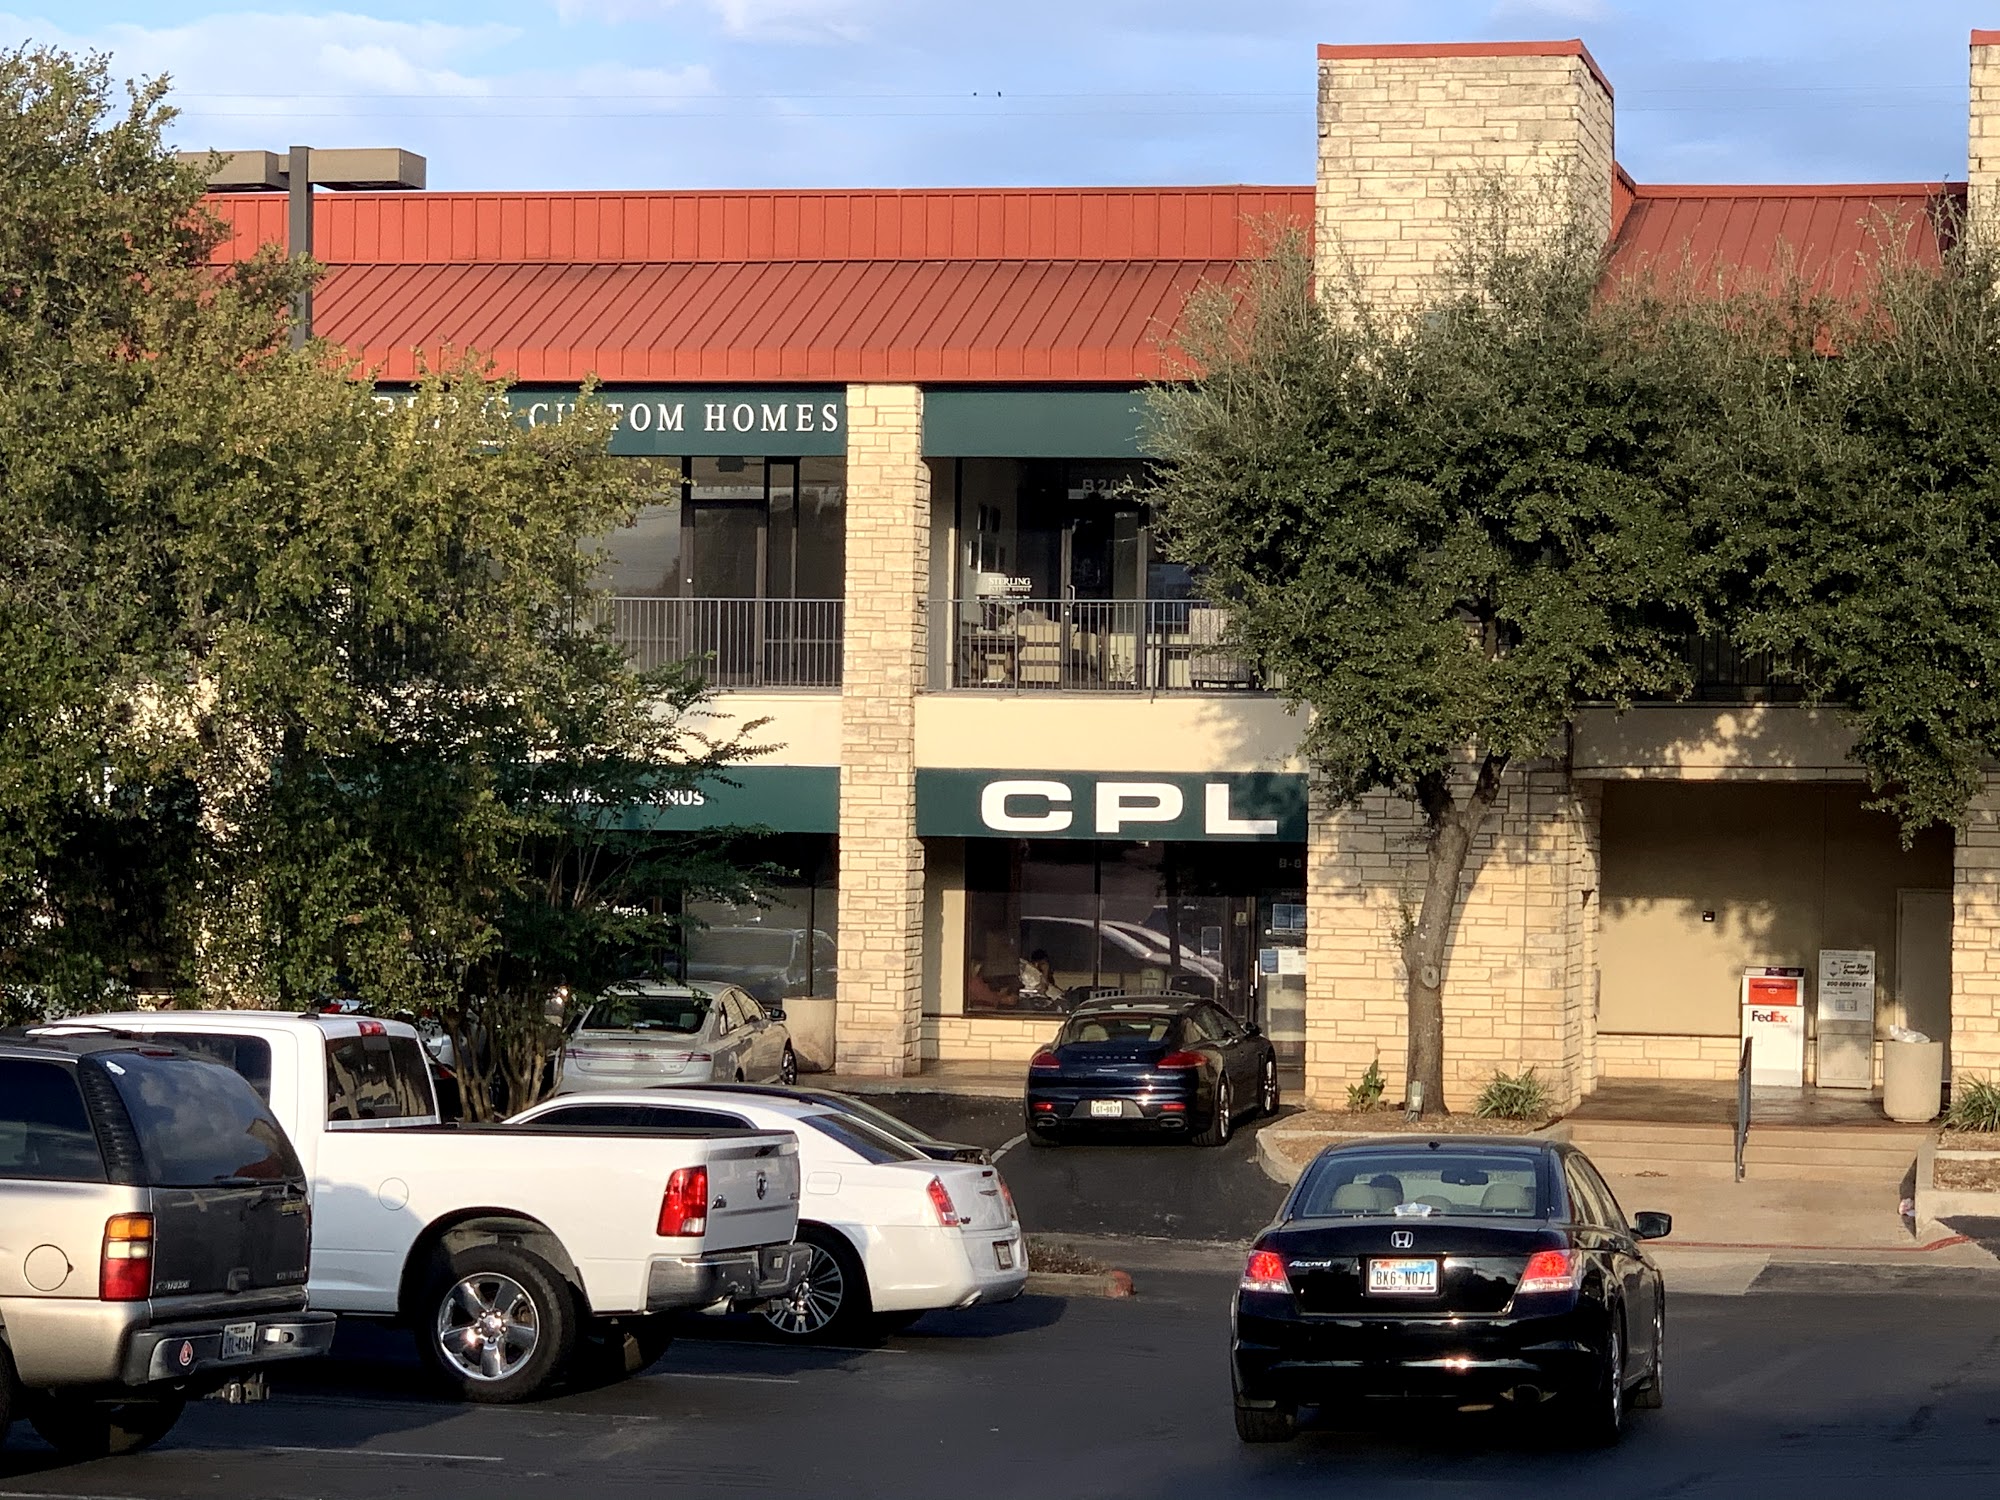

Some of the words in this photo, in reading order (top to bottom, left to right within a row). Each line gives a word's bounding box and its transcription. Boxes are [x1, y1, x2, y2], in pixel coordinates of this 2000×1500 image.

[704, 403, 839, 432] HOMES
[988, 577, 1031, 586] STERLING
[981, 780, 1278, 835] CPL
[1751, 1010, 1789, 1023] FedEx
[1288, 1260, 1332, 1268] Accord
